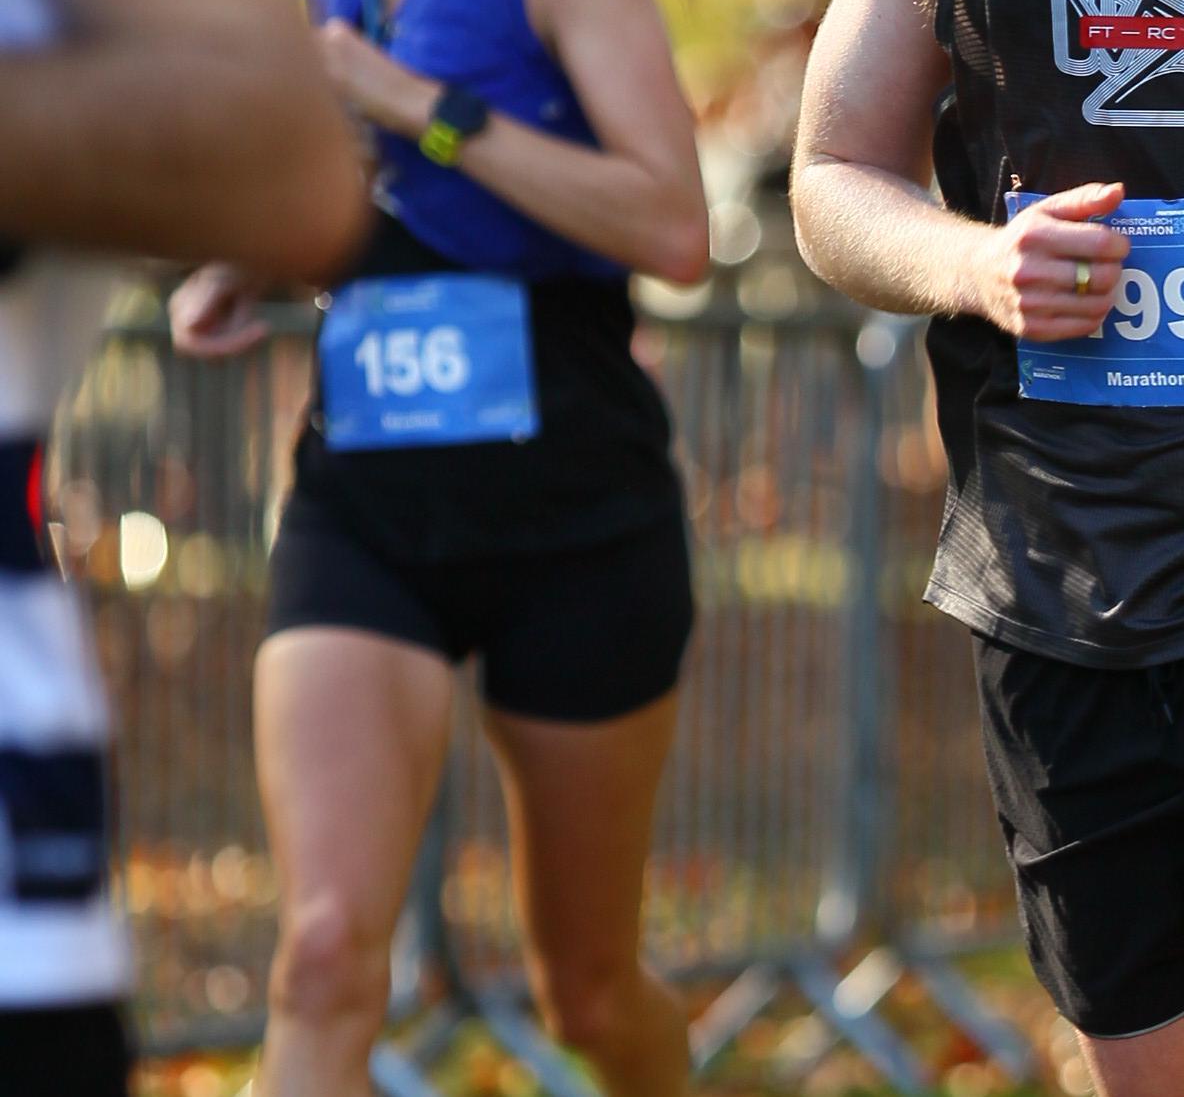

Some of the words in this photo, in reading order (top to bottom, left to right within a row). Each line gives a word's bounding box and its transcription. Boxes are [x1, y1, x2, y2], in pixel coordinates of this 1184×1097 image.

[1088, 26, 1115, 38] FT
[1147, 27, 1176, 40] RC
[1111, 217, 1173, 226] CHRISTCHURCH
[1111, 226, 1174, 236] MARATHON
[354, 325, 470, 397] 156
